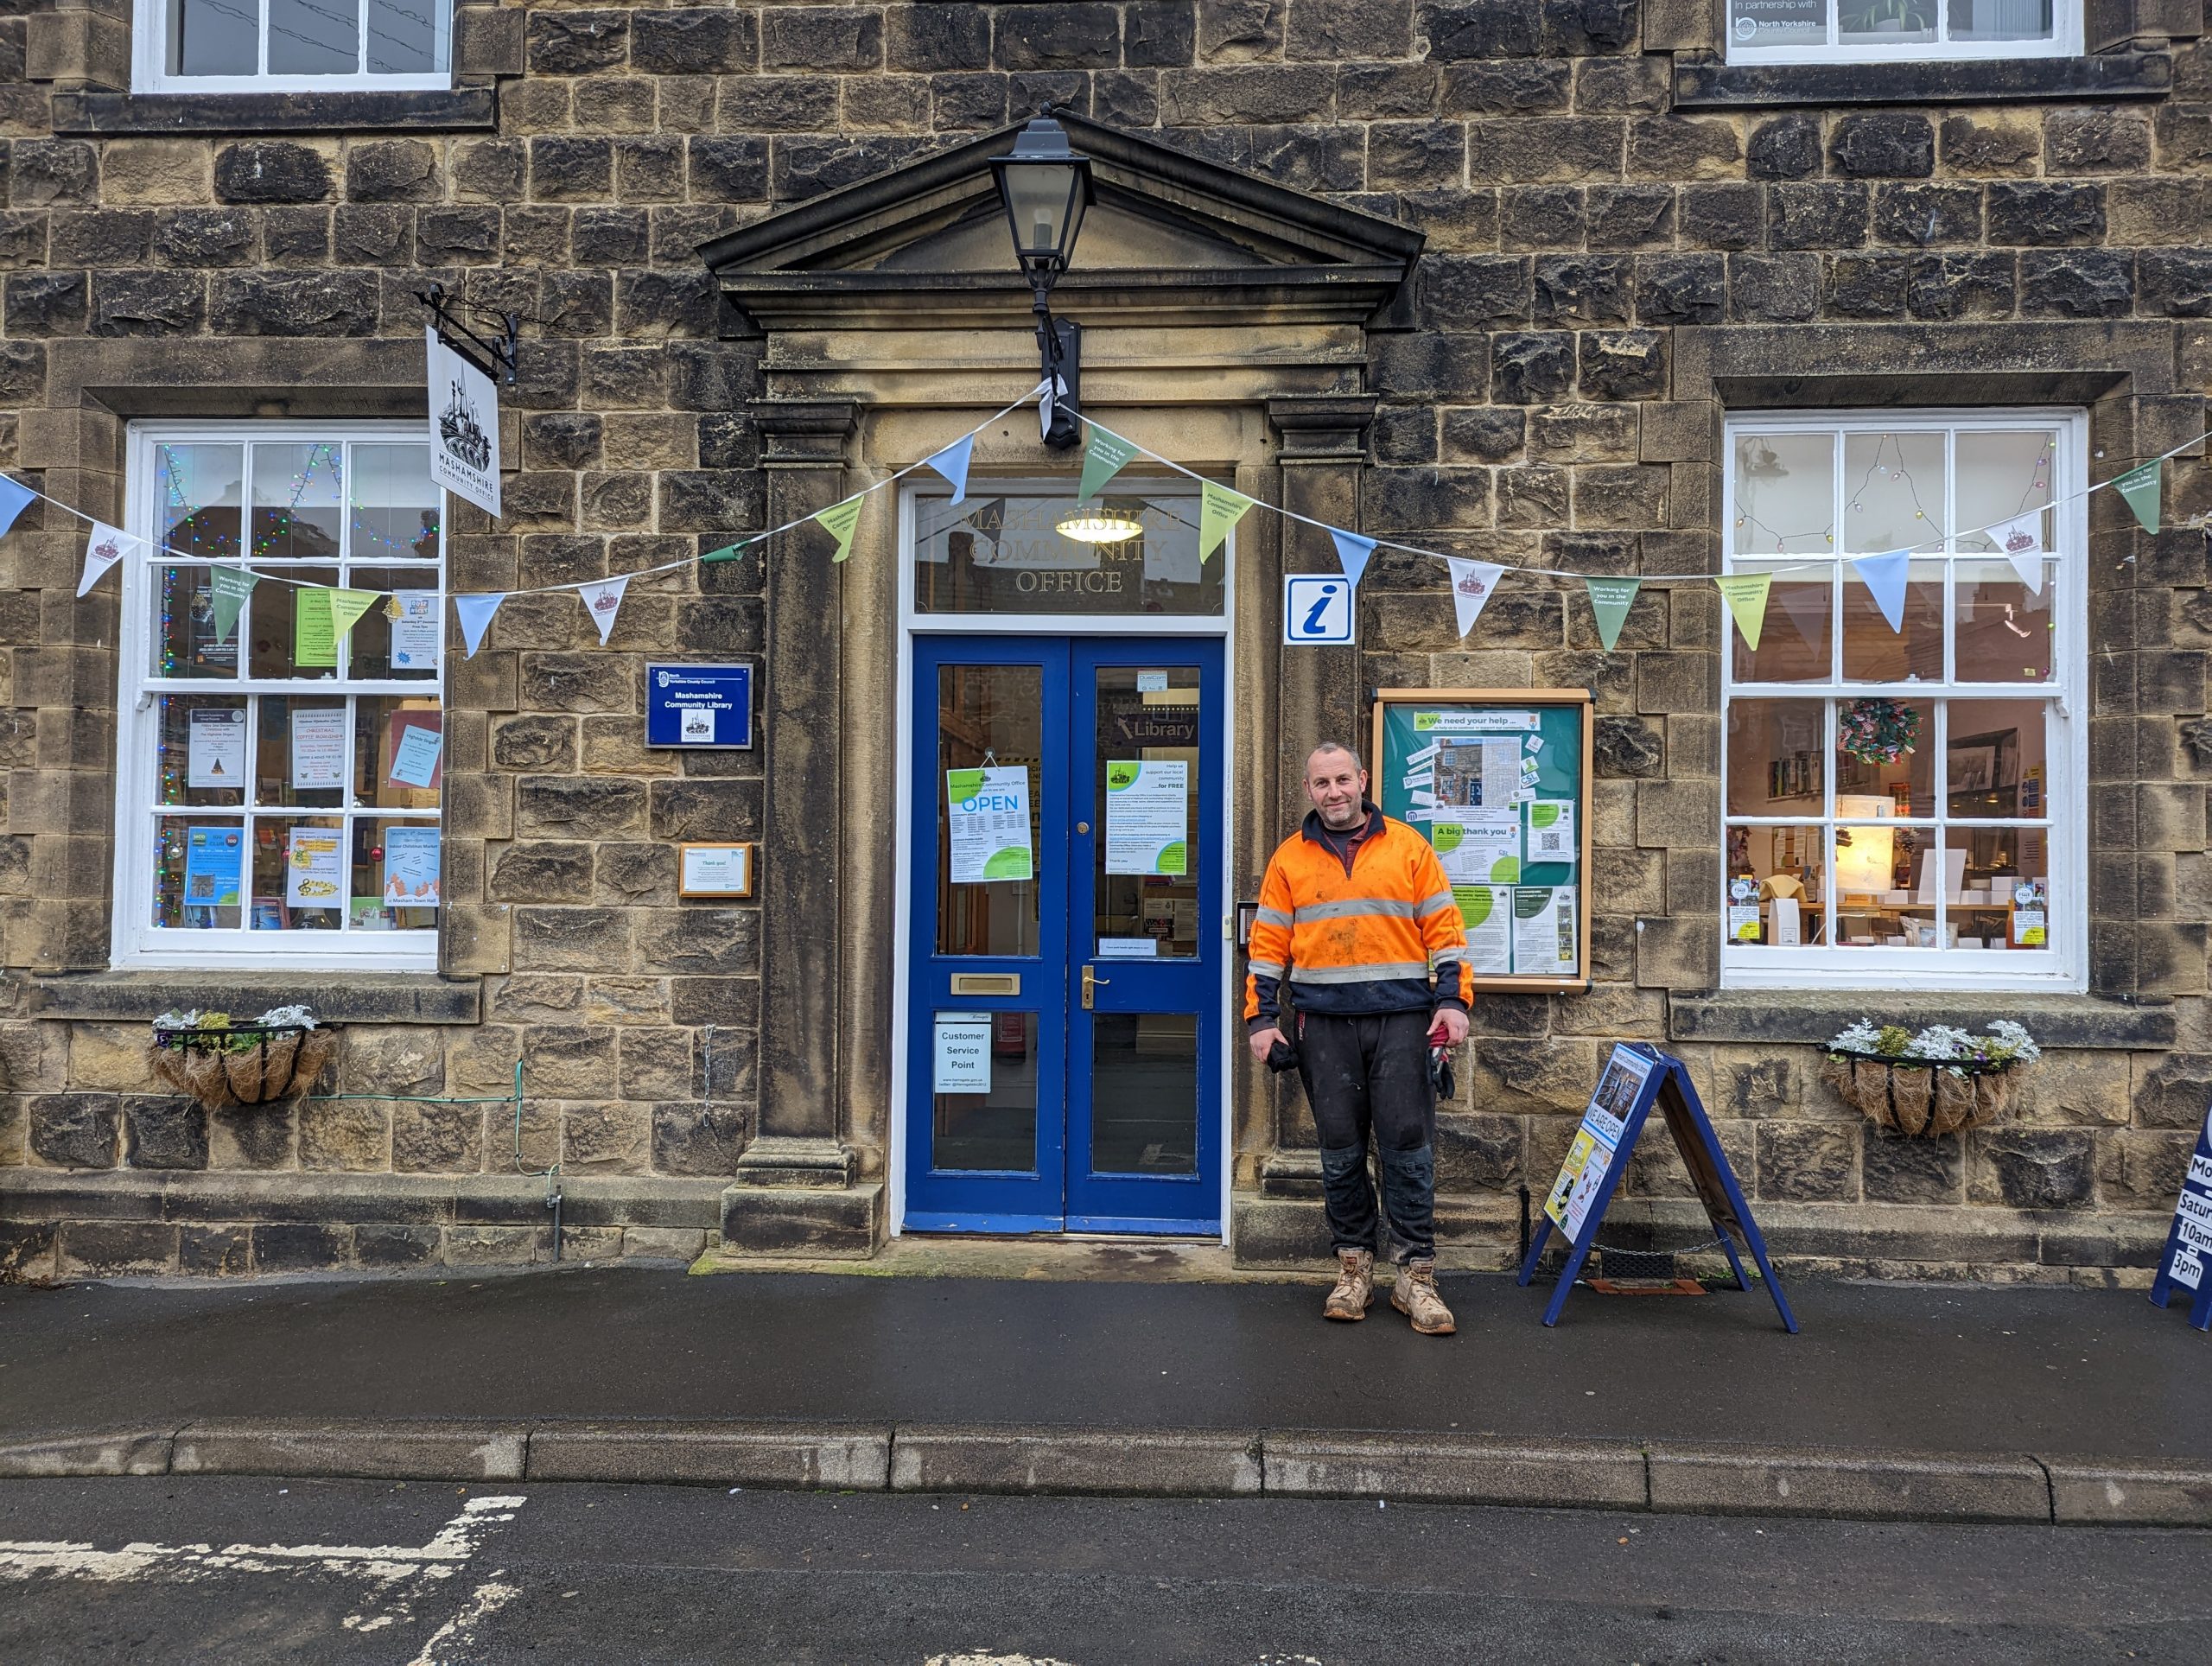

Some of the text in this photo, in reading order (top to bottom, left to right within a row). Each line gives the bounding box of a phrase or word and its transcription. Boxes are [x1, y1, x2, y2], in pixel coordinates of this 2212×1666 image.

[1745, 0, 1796, 10] partnership
[1797, 0, 1816, 9] with
[1093, 445, 1104, 454] you
[1095, 437, 1117, 454] Working
[1089, 449, 1119, 469] Community
[439, 452, 493, 493] MASHAMSHIRE
[439, 465, 474, 490] COMMUNITY
[474, 486, 493, 502] OFFICE
[2121, 480, 2157, 493] Community
[1206, 500, 1238, 516] Community
[1207, 493, 1243, 510] Mashamshire
[958, 508, 1182, 531] MASHAMSHIRE
[1211, 509, 1228, 518] Office
[969, 539, 1167, 562] COMMUNITY
[219, 575, 242, 586] Working
[1016, 571, 1122, 593] OFFICE
[215, 588, 245, 601] Community
[1489, 716, 1509, 725] help
[1135, 722, 1194, 740] Library
[1521, 773, 1537, 784] CSL
[963, 795, 1018, 812] OPEN
[1446, 827, 1460, 836] big
[1587, 1107, 1623, 1141] WE ARE OPEN
[2183, 1222, 2212, 1250] 10am
[2174, 1253, 2201, 1279] 3pm
